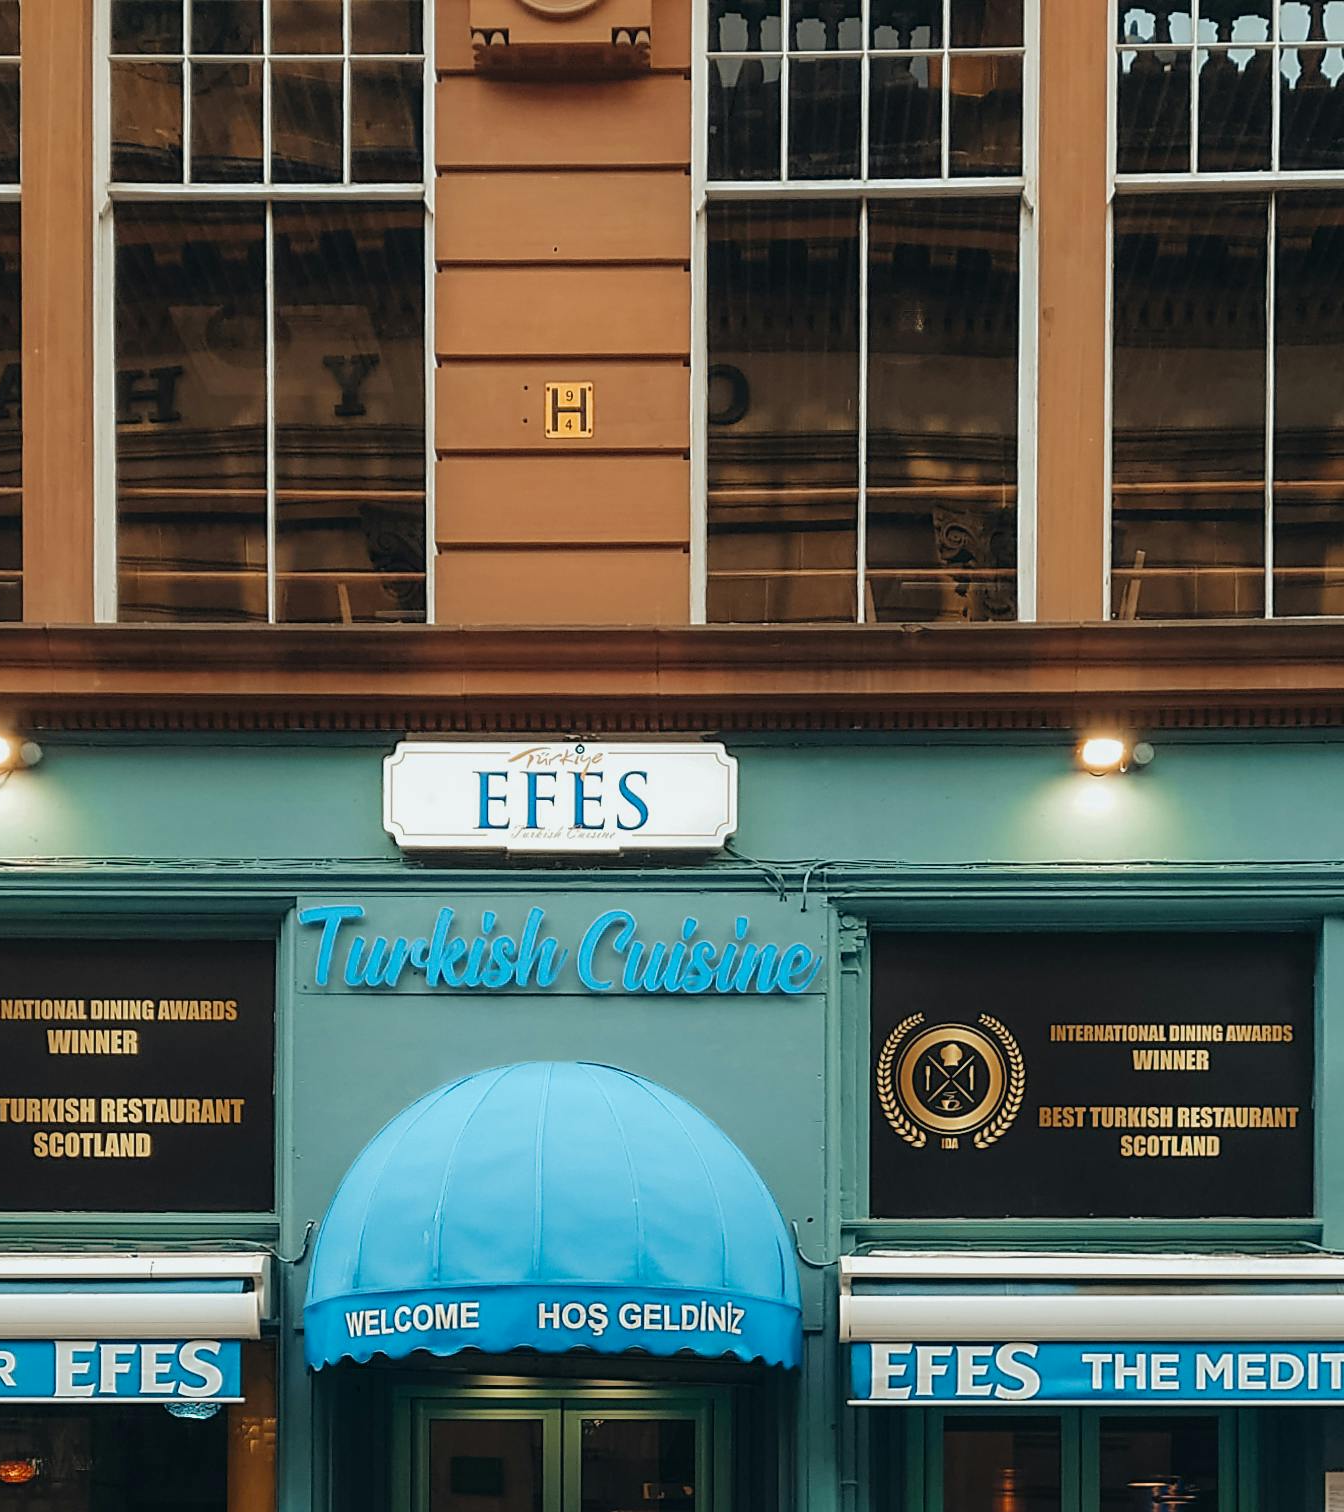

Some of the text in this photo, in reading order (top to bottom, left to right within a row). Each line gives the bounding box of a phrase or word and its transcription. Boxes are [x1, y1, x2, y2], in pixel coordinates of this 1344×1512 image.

[565, 390, 574, 402] 9
[551, 387, 587, 432] H
[565, 418, 573, 431] 4
[472, 770, 649, 831] EFES
[296, 904, 823, 994] Turkish Cuisine
[90, 999, 154, 1020] DINING
[157, 1000, 238, 1021] AWARDS
[47, 1029, 138, 1055] WINNER
[1050, 1024, 1293, 1043] INTERNATIONAL DINING AWARDS
[1132, 1049, 1210, 1071] WINNER
[100, 1098, 246, 1124] RESTAURANT
[1038, 1106, 1299, 1128] BEST TURKISH RESTAURANT
[33, 1132, 152, 1158] SCOTLAND
[941, 1137, 959, 1150] IDA
[1120, 1134, 1221, 1157] SCOTLAND
[345, 1302, 480, 1338] WELCOME
[538, 1302, 609, 1336] HOŞ
[54, 1340, 223, 1397] EFES
[869, 1341, 1041, 1400] EFES
[1081, 1352, 1181, 1391] THE
